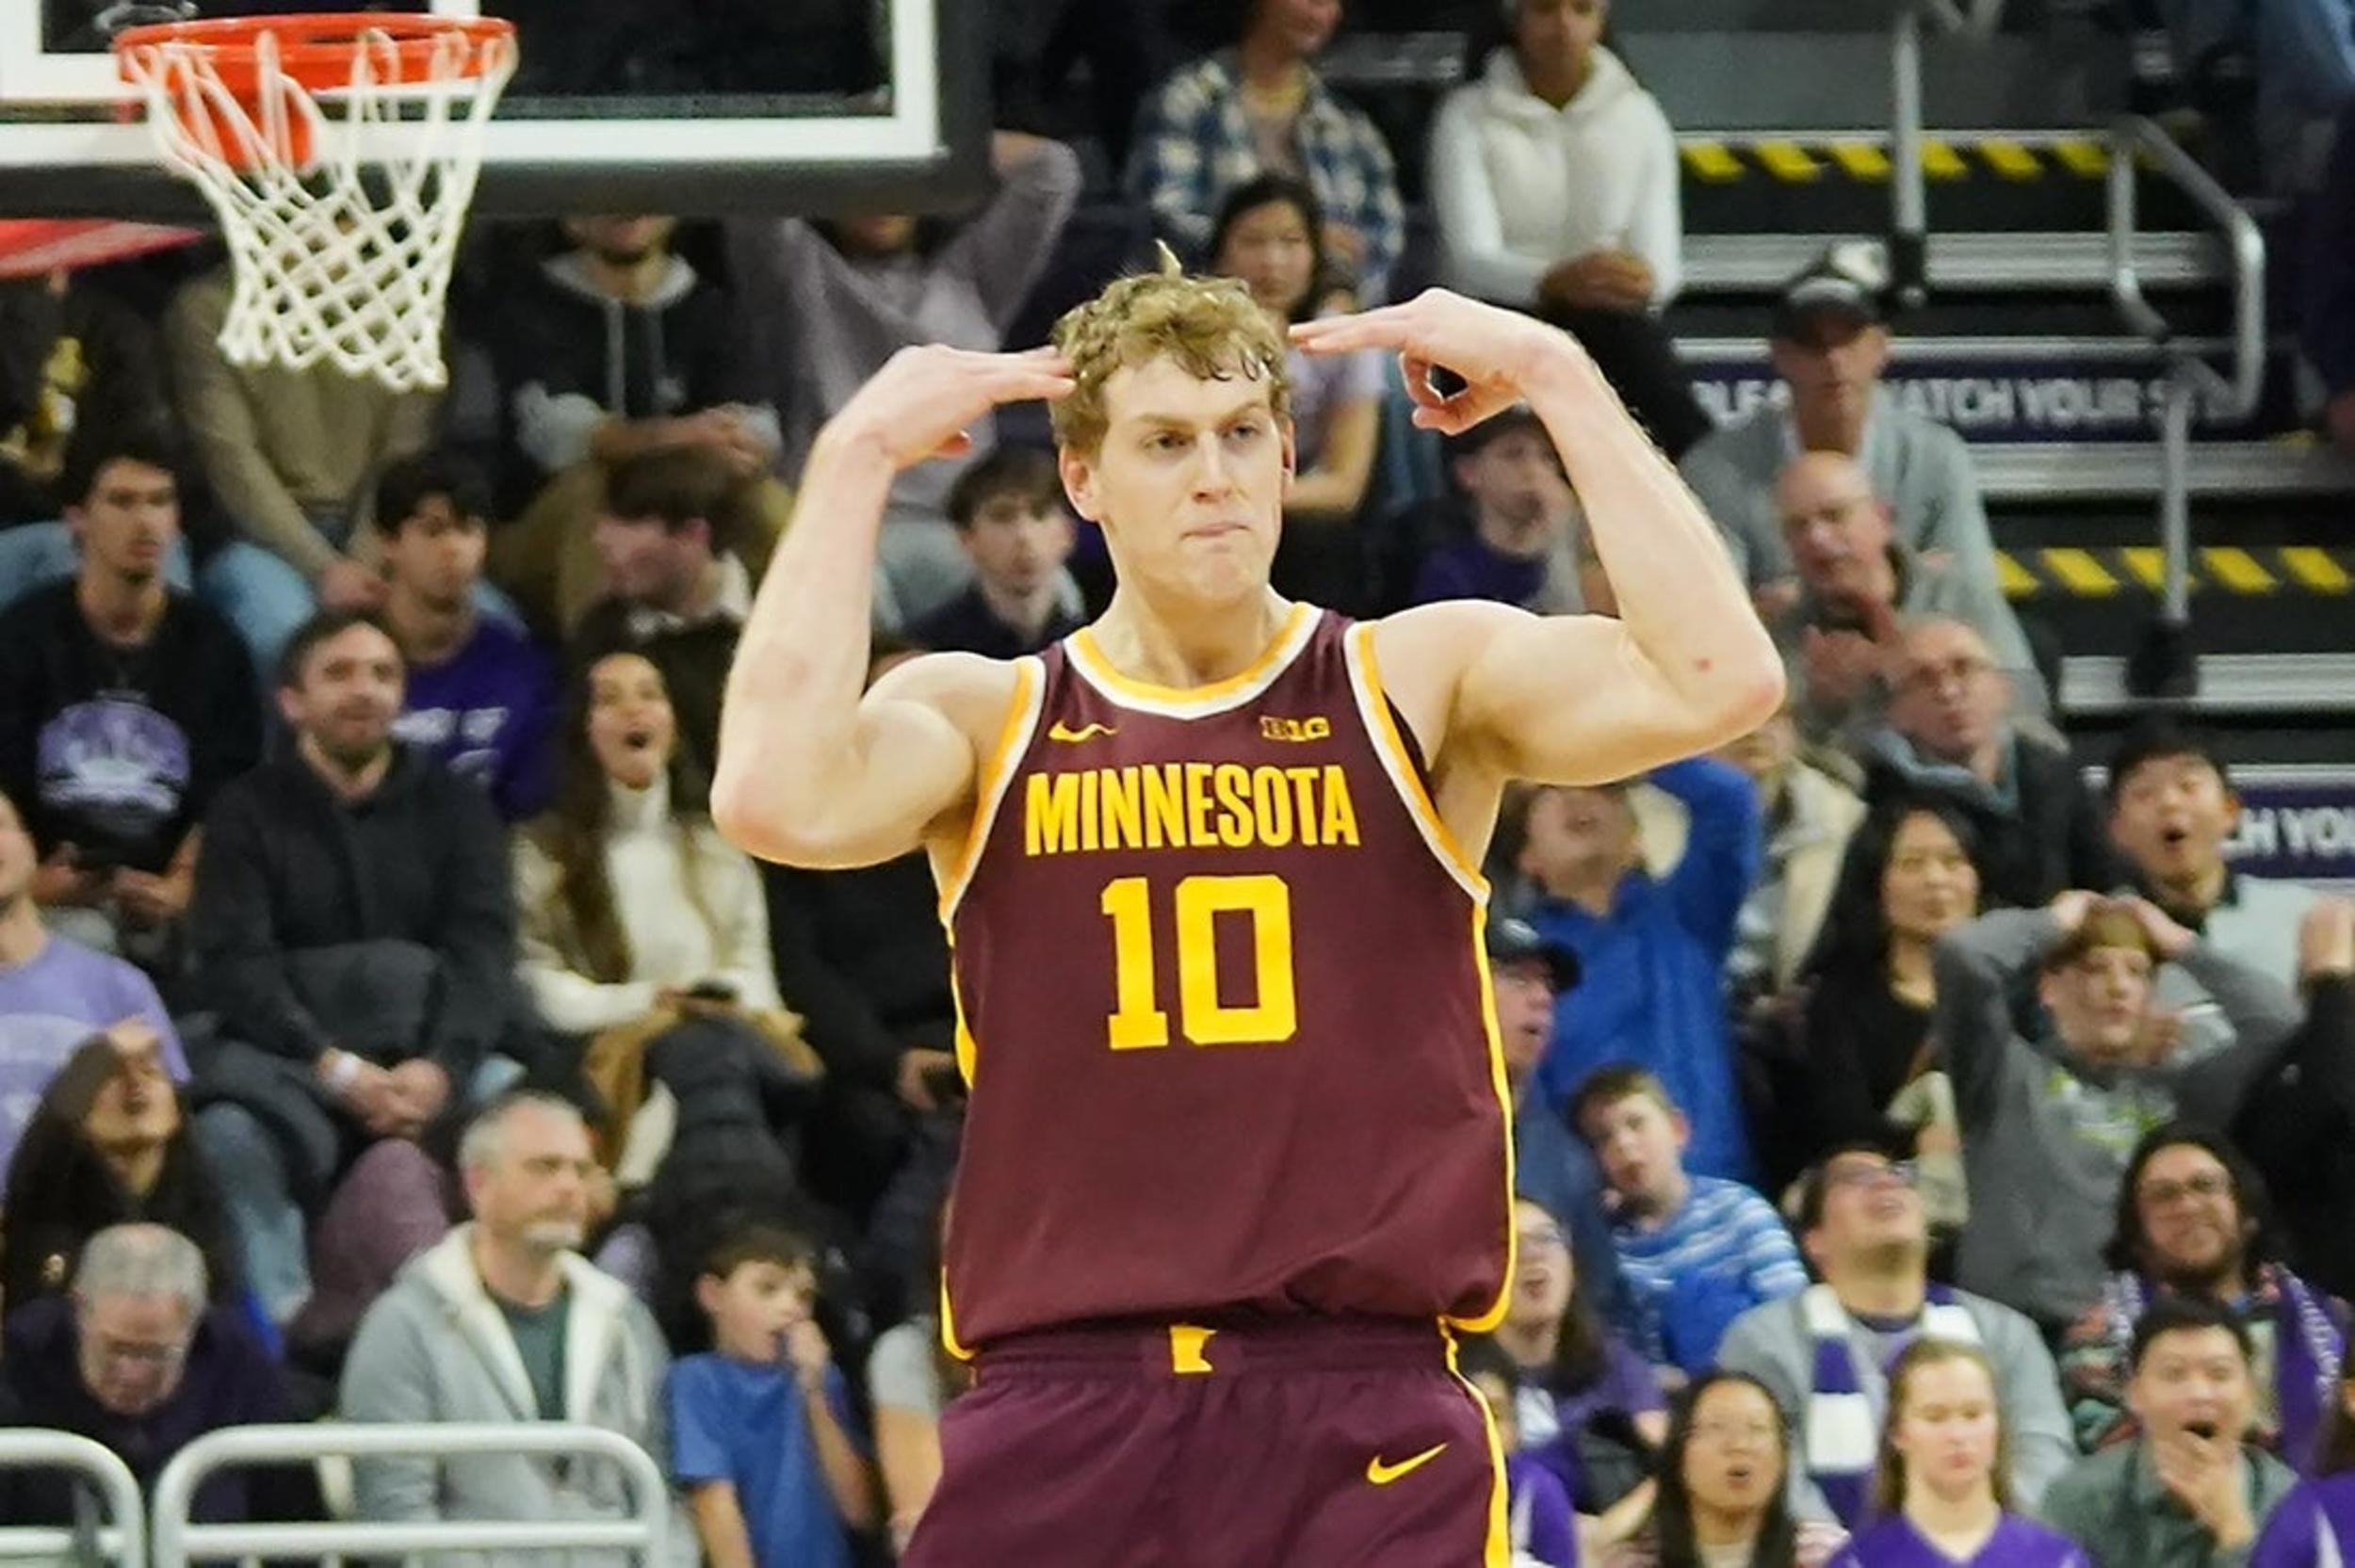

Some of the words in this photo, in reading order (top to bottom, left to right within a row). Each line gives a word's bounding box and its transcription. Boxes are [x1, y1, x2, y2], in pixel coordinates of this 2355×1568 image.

[1876, 379, 2014, 424] ATCH
[2019, 379, 2141, 424] YOUR
[1025, 762, 1360, 856] MINNESOTA
[1100, 873, 1297, 1050] 10
